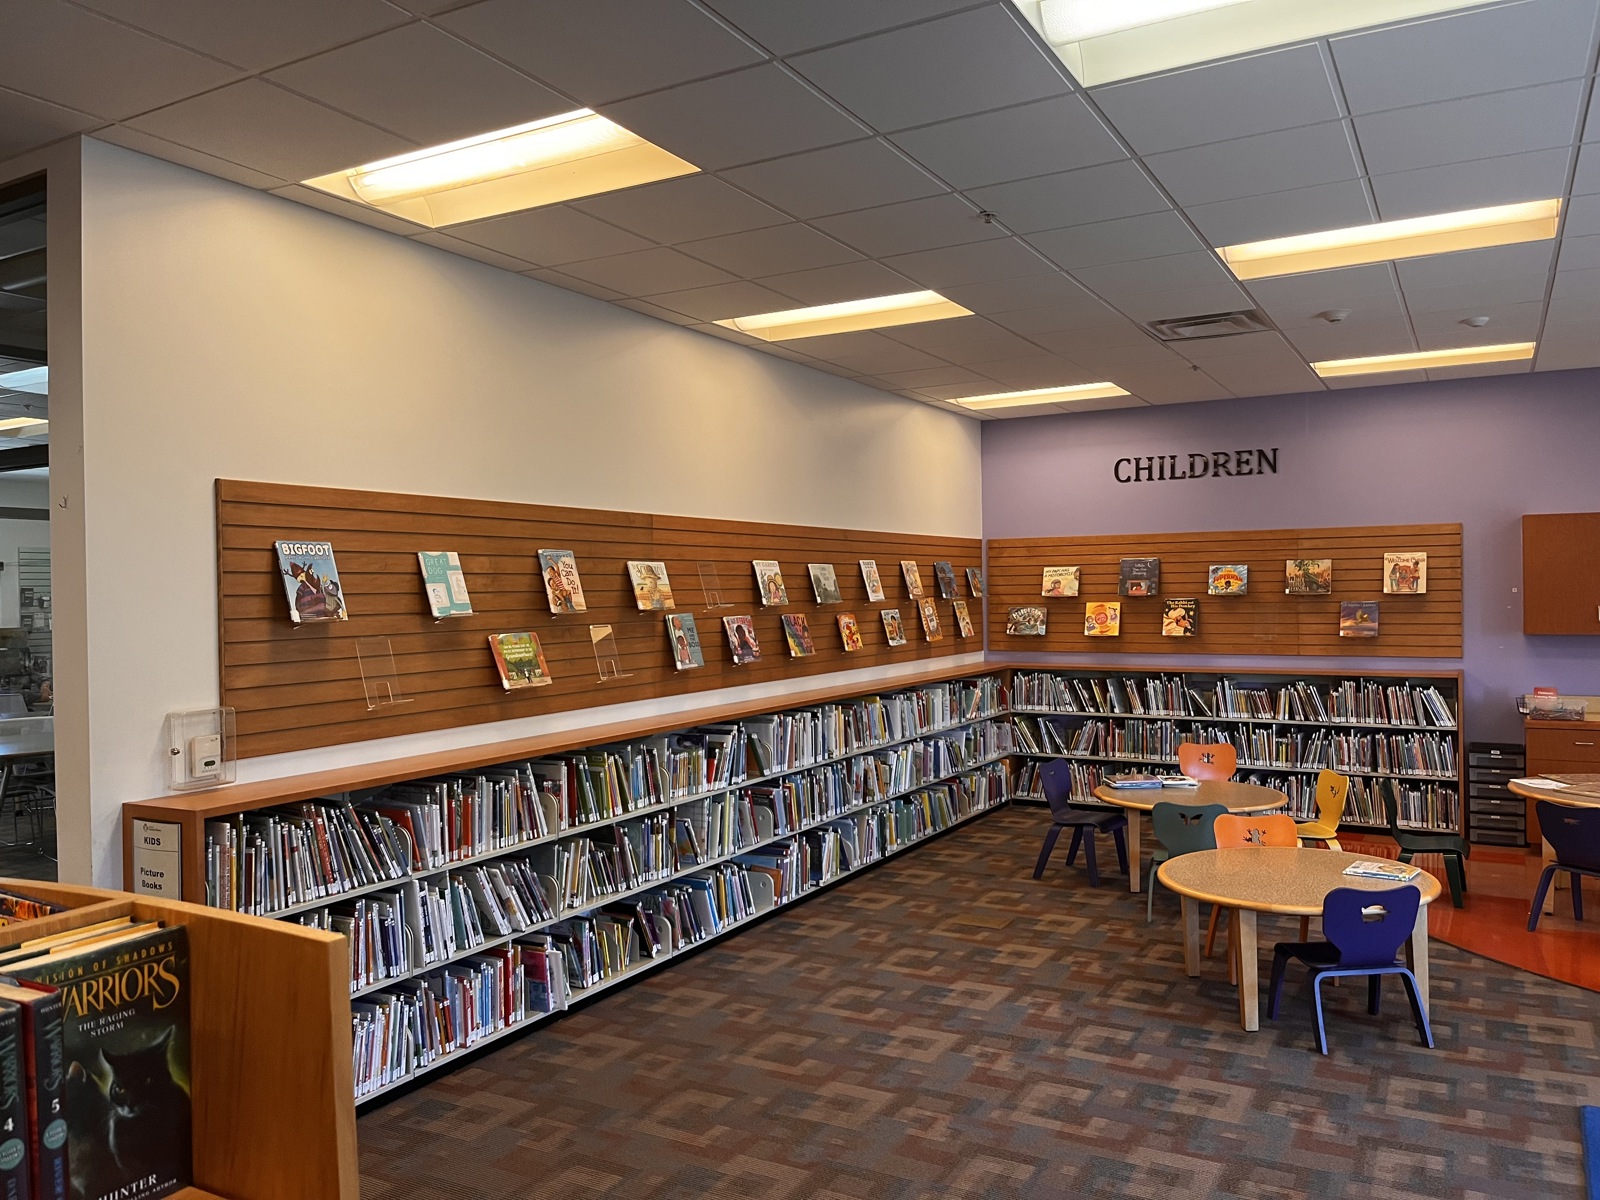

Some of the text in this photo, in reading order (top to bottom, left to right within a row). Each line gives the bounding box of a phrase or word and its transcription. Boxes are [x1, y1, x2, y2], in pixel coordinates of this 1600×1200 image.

[1113, 448, 1279, 483] CHILDREN
[281, 543, 330, 556] BIGFOOT
[425, 558, 448, 567] GREAT
[561, 560, 574, 570] You
[561, 569, 574, 577] Can
[566, 577, 576, 586] Do
[784, 615, 805, 627] BLACK
[143, 836, 161, 846] KIDS
[140, 867, 165, 878] Picture
[142, 880, 163, 890] Books
[93, 959, 106, 972] OF
[116, 941, 173, 966] SHADOWS
[62, 954, 180, 1024] ARRIORS
[78, 1008, 136, 1032] THE RAGING
[90, 1021, 124, 1038] STORM
[51, 1098, 60, 1113] 5
[4, 1117, 14, 1131] 4
